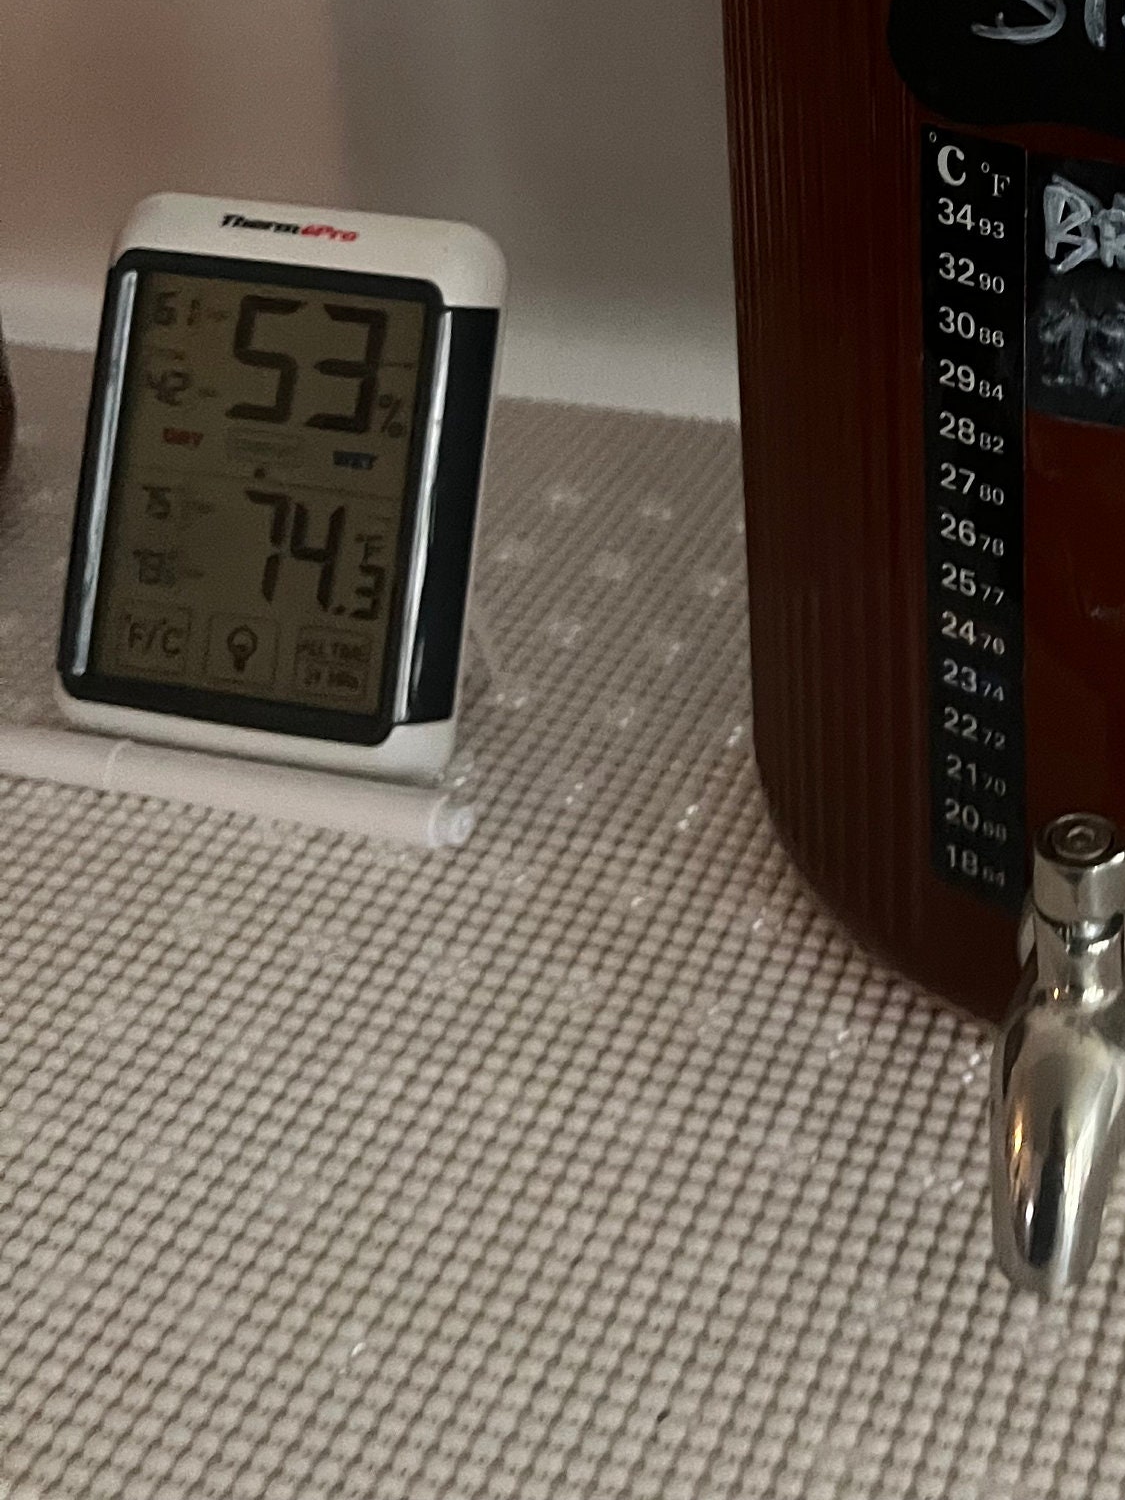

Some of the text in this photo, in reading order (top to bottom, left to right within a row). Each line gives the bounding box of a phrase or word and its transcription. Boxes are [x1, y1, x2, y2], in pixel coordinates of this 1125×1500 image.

[937, 197, 1005, 239] 34 93
[939, 252, 1005, 294] 32 90
[939, 306, 976, 339] 30
[939, 359, 1004, 401] 29 84
[939, 410, 1004, 454] 28 82
[940, 462, 1004, 506] 27 80
[940, 513, 976, 547] 26
[941, 562, 1005, 606] 25 77
[941, 610, 977, 646] 24
[942, 658, 977, 693] 23
[943, 706, 978, 741] 22
[946, 754, 978, 790] 21
[944, 798, 980, 833] 20
